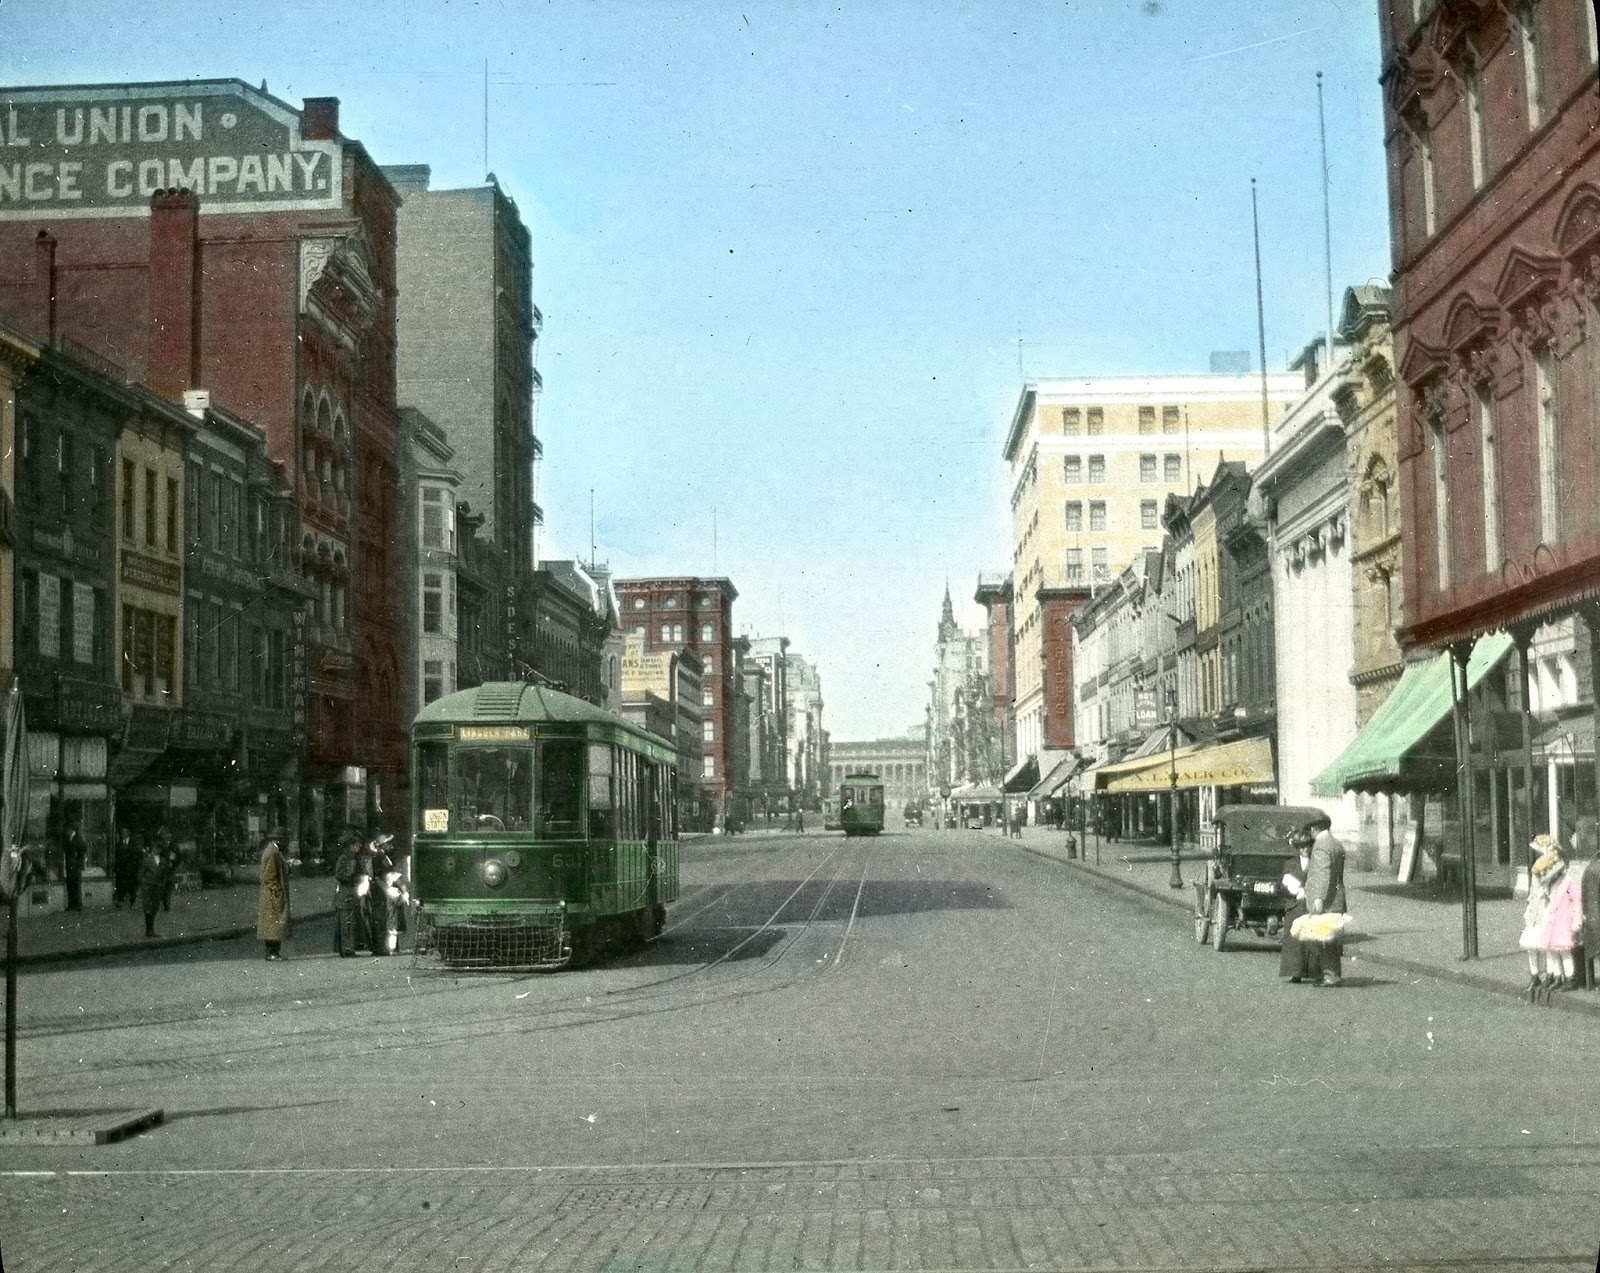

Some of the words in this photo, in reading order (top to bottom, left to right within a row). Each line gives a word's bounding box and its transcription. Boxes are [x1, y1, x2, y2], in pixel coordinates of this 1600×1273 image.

[0, 110, 31, 147] L
[56, 102, 203, 146] UNION
[0, 161, 84, 202] NCE
[106, 152, 326, 199] COMPANY.
[292, 611, 306, 724] WINEMAN
[1136, 710, 1158, 720] LOAN
[429, 811, 448, 821] UNION
